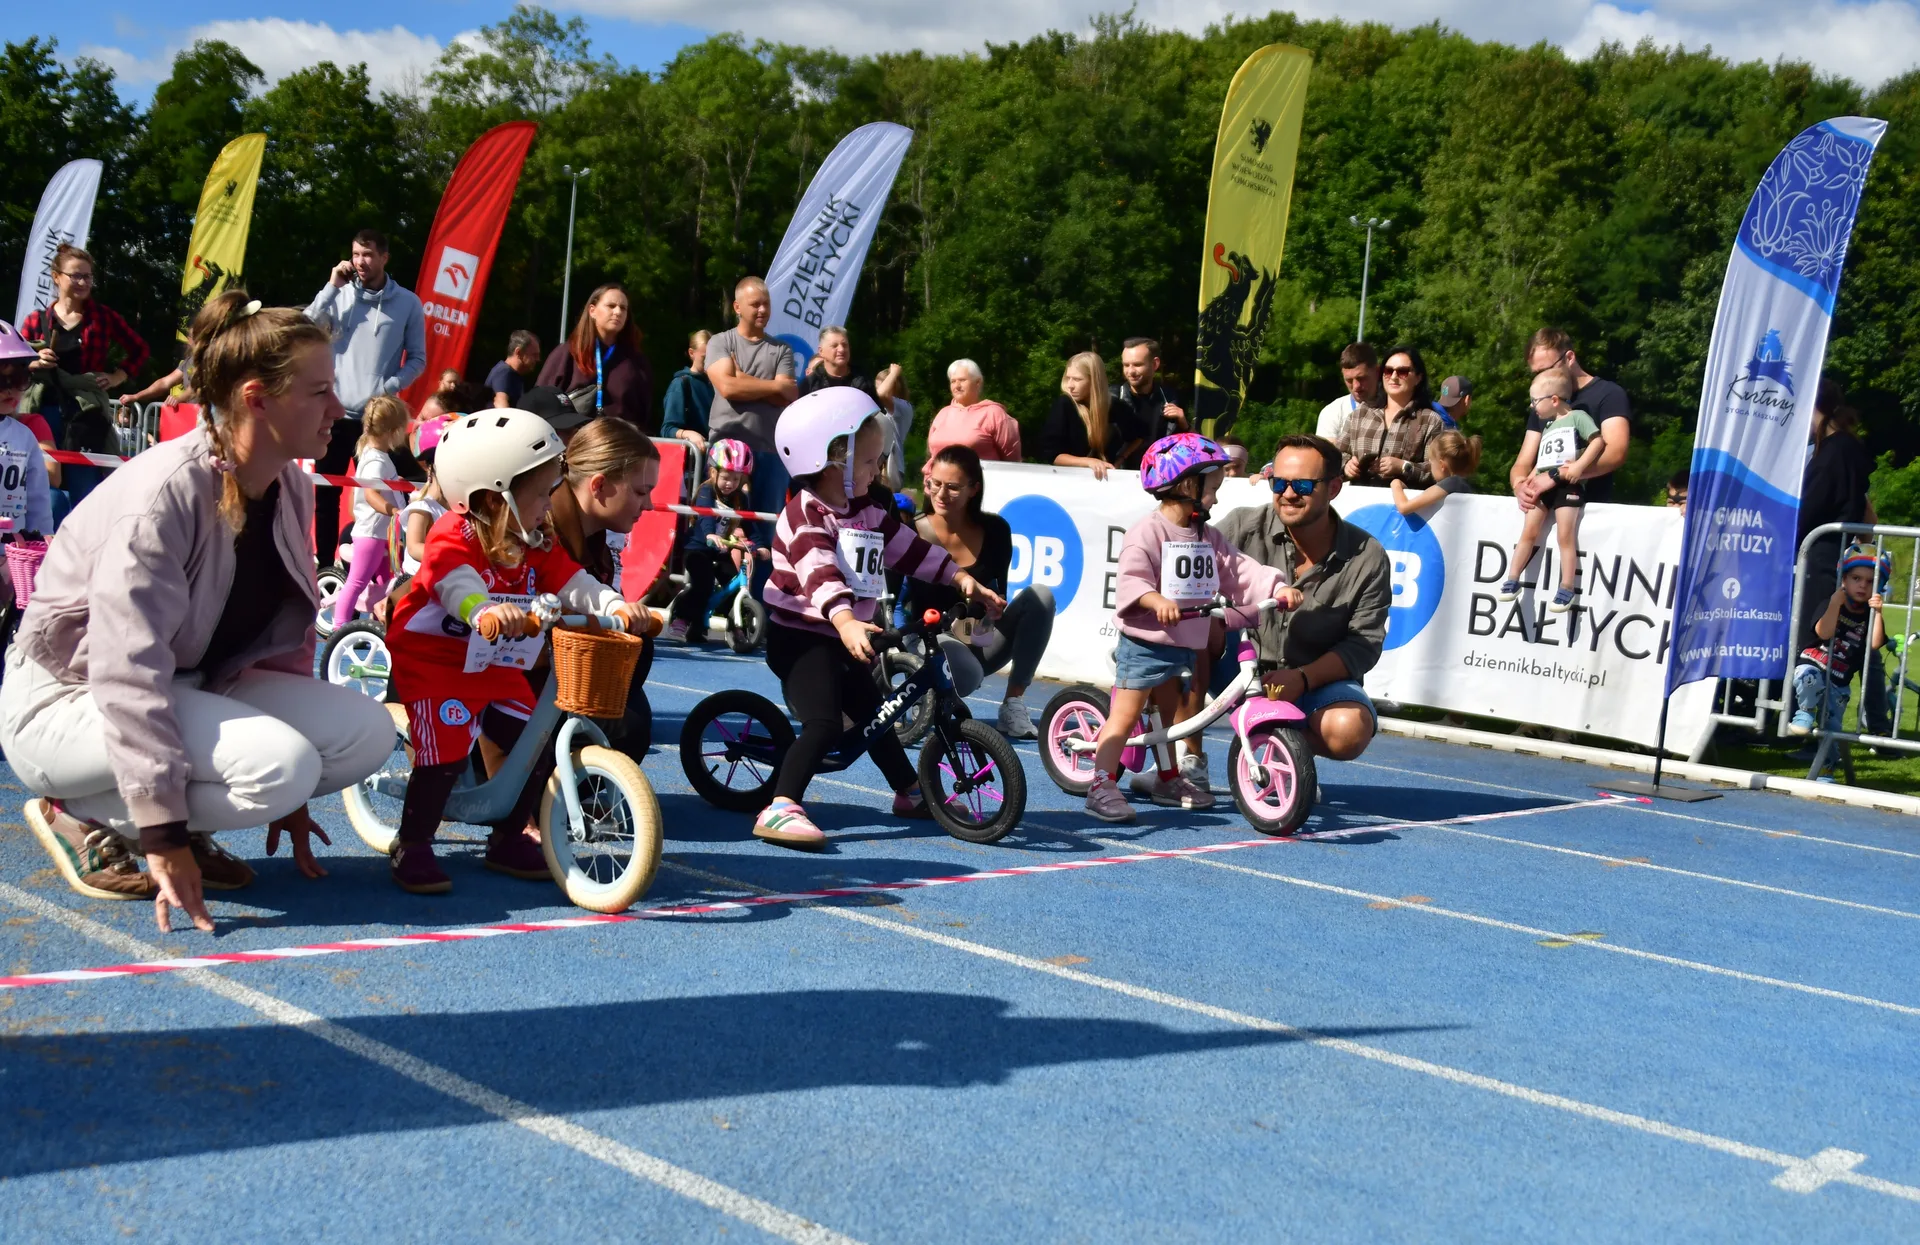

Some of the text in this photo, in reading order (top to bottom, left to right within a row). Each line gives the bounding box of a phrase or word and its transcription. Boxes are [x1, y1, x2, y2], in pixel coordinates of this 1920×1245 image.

[34, 226, 61, 311] ZIENNIK
[783, 192, 842, 320] DZIENNIK
[804, 201, 861, 330] BAŁTYCKI
[423, 301, 469, 327] ORLEN
[434, 322, 450, 336] OIL
[1715, 506, 1763, 528] GMINA
[1175, 554, 1214, 579] 098
[1386, 549, 1422, 608] B
[1473, 539, 1679, 611] DZIENNI
[1467, 591, 1673, 665] BAŁTYC
